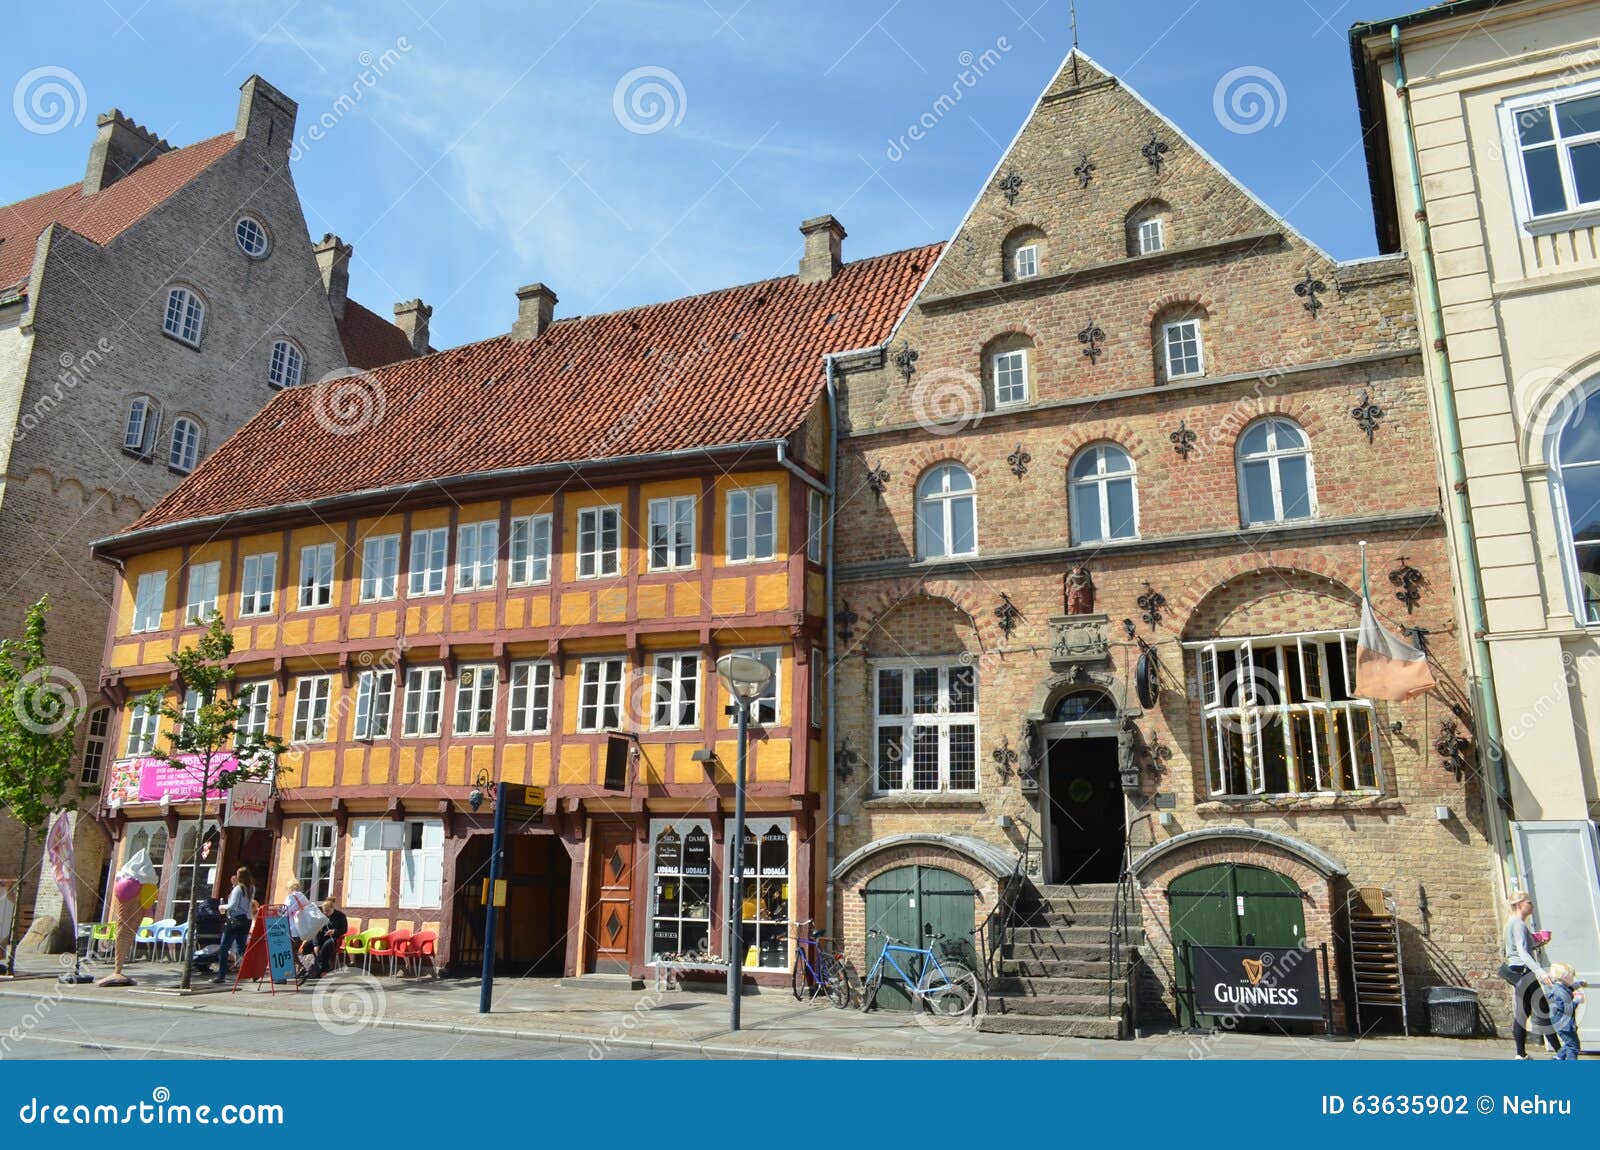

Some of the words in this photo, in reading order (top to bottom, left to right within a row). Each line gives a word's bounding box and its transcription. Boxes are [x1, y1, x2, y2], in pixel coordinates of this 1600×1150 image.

[657, 866, 679, 874] UDSALG
[685, 867, 708, 875] UDSALG
[762, 867, 786, 875] UDSALG
[1214, 982, 1298, 1006] GUINNESS
